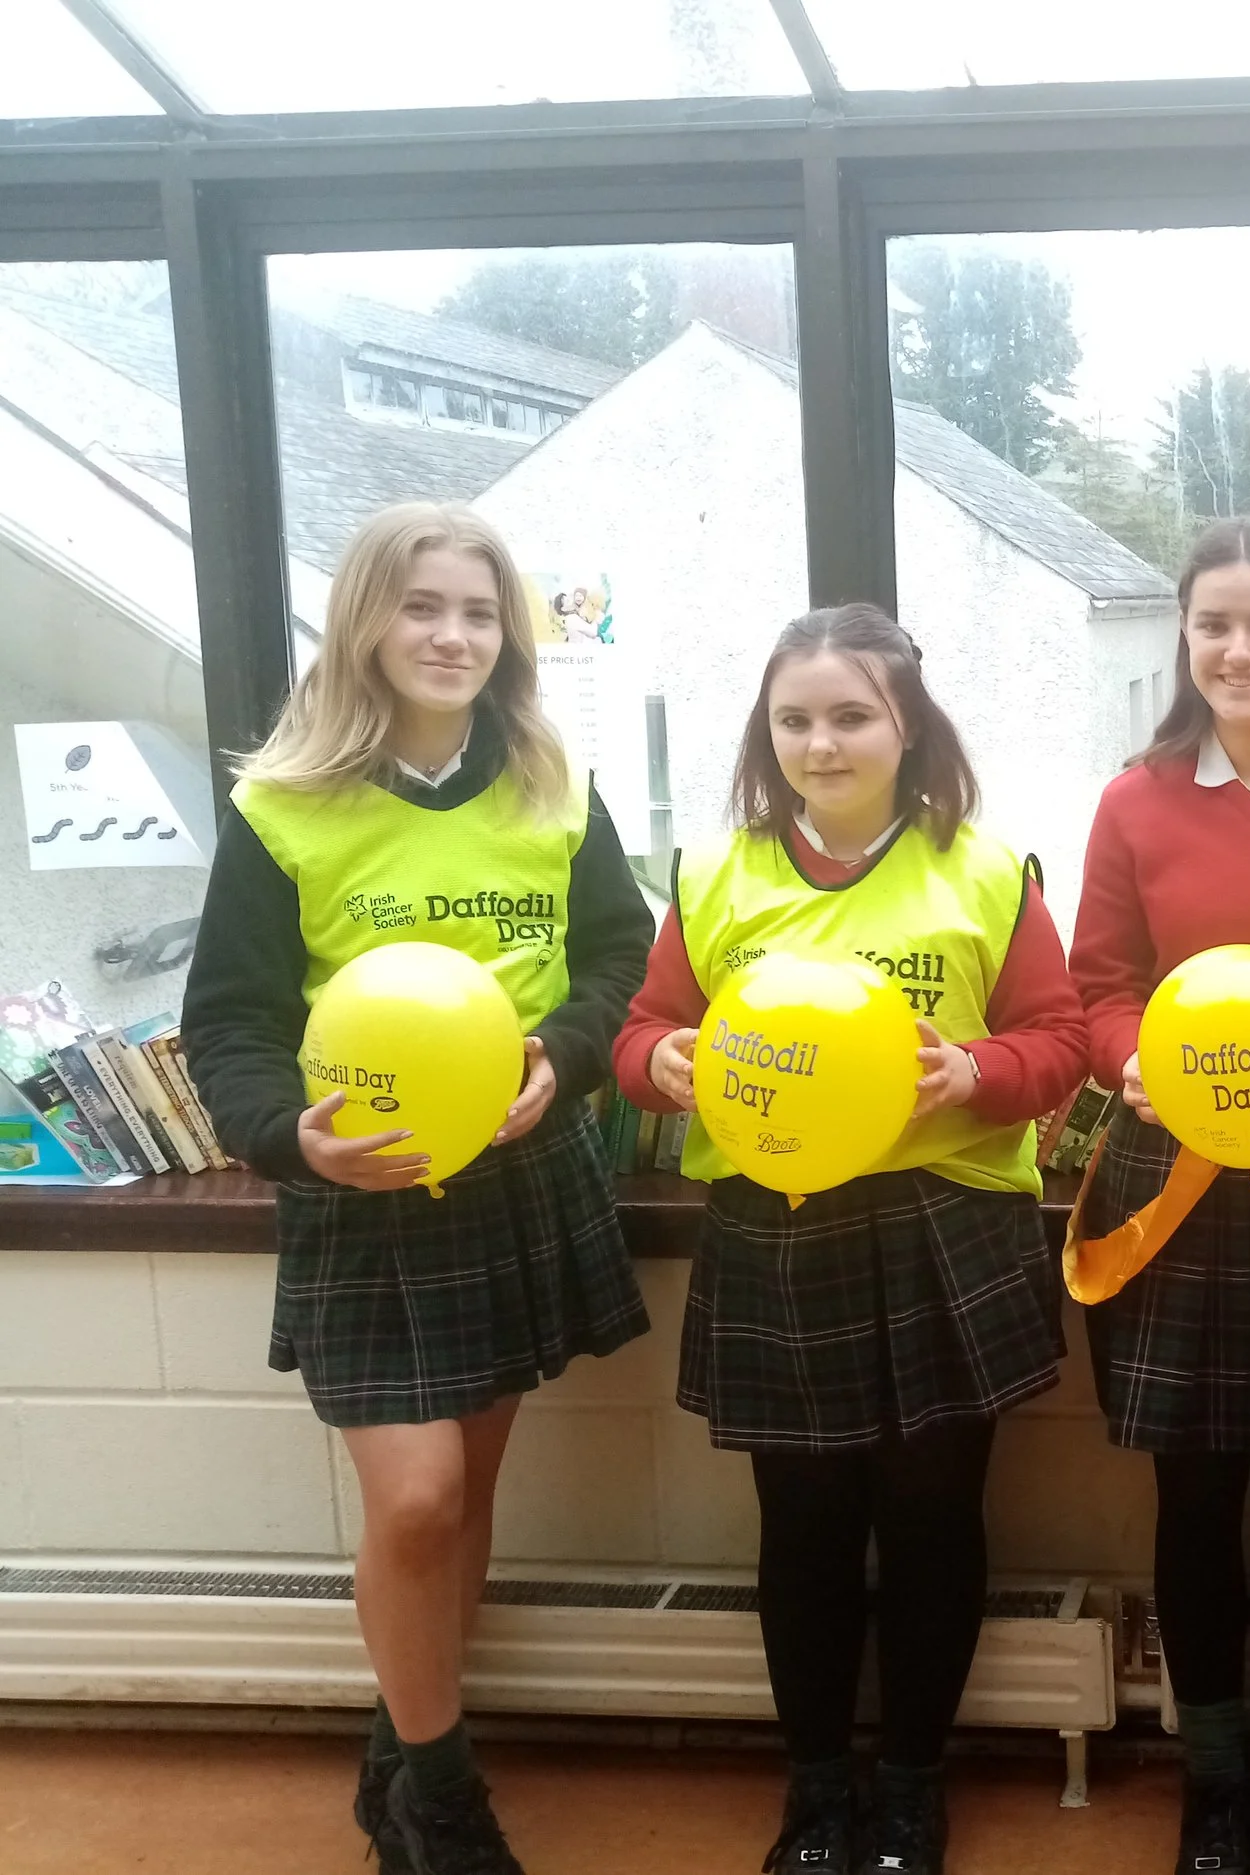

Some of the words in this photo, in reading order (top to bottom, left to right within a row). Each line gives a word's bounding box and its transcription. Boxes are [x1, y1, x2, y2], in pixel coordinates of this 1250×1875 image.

[551, 656, 575, 665] PRICE
[577, 656, 594, 665] LIST
[50, 783, 68, 792] 5th
[369, 893, 396, 907] Irish
[371, 903, 413, 919] Cancer
[425, 891, 554, 922] Daffodil
[374, 915, 417, 930] Society
[495, 918, 555, 946] Day
[743, 947, 766, 960] Irish
[855, 950, 944, 982] odil
[711, 1018, 818, 1076] Daffodil
[111, 1053, 140, 1091] requiem
[354, 1068, 396, 1093] Day
[723, 1069, 777, 1118] Day
[127, 1115, 160, 1164] EVERYTHING
[754, 1132, 802, 1154] Boots
